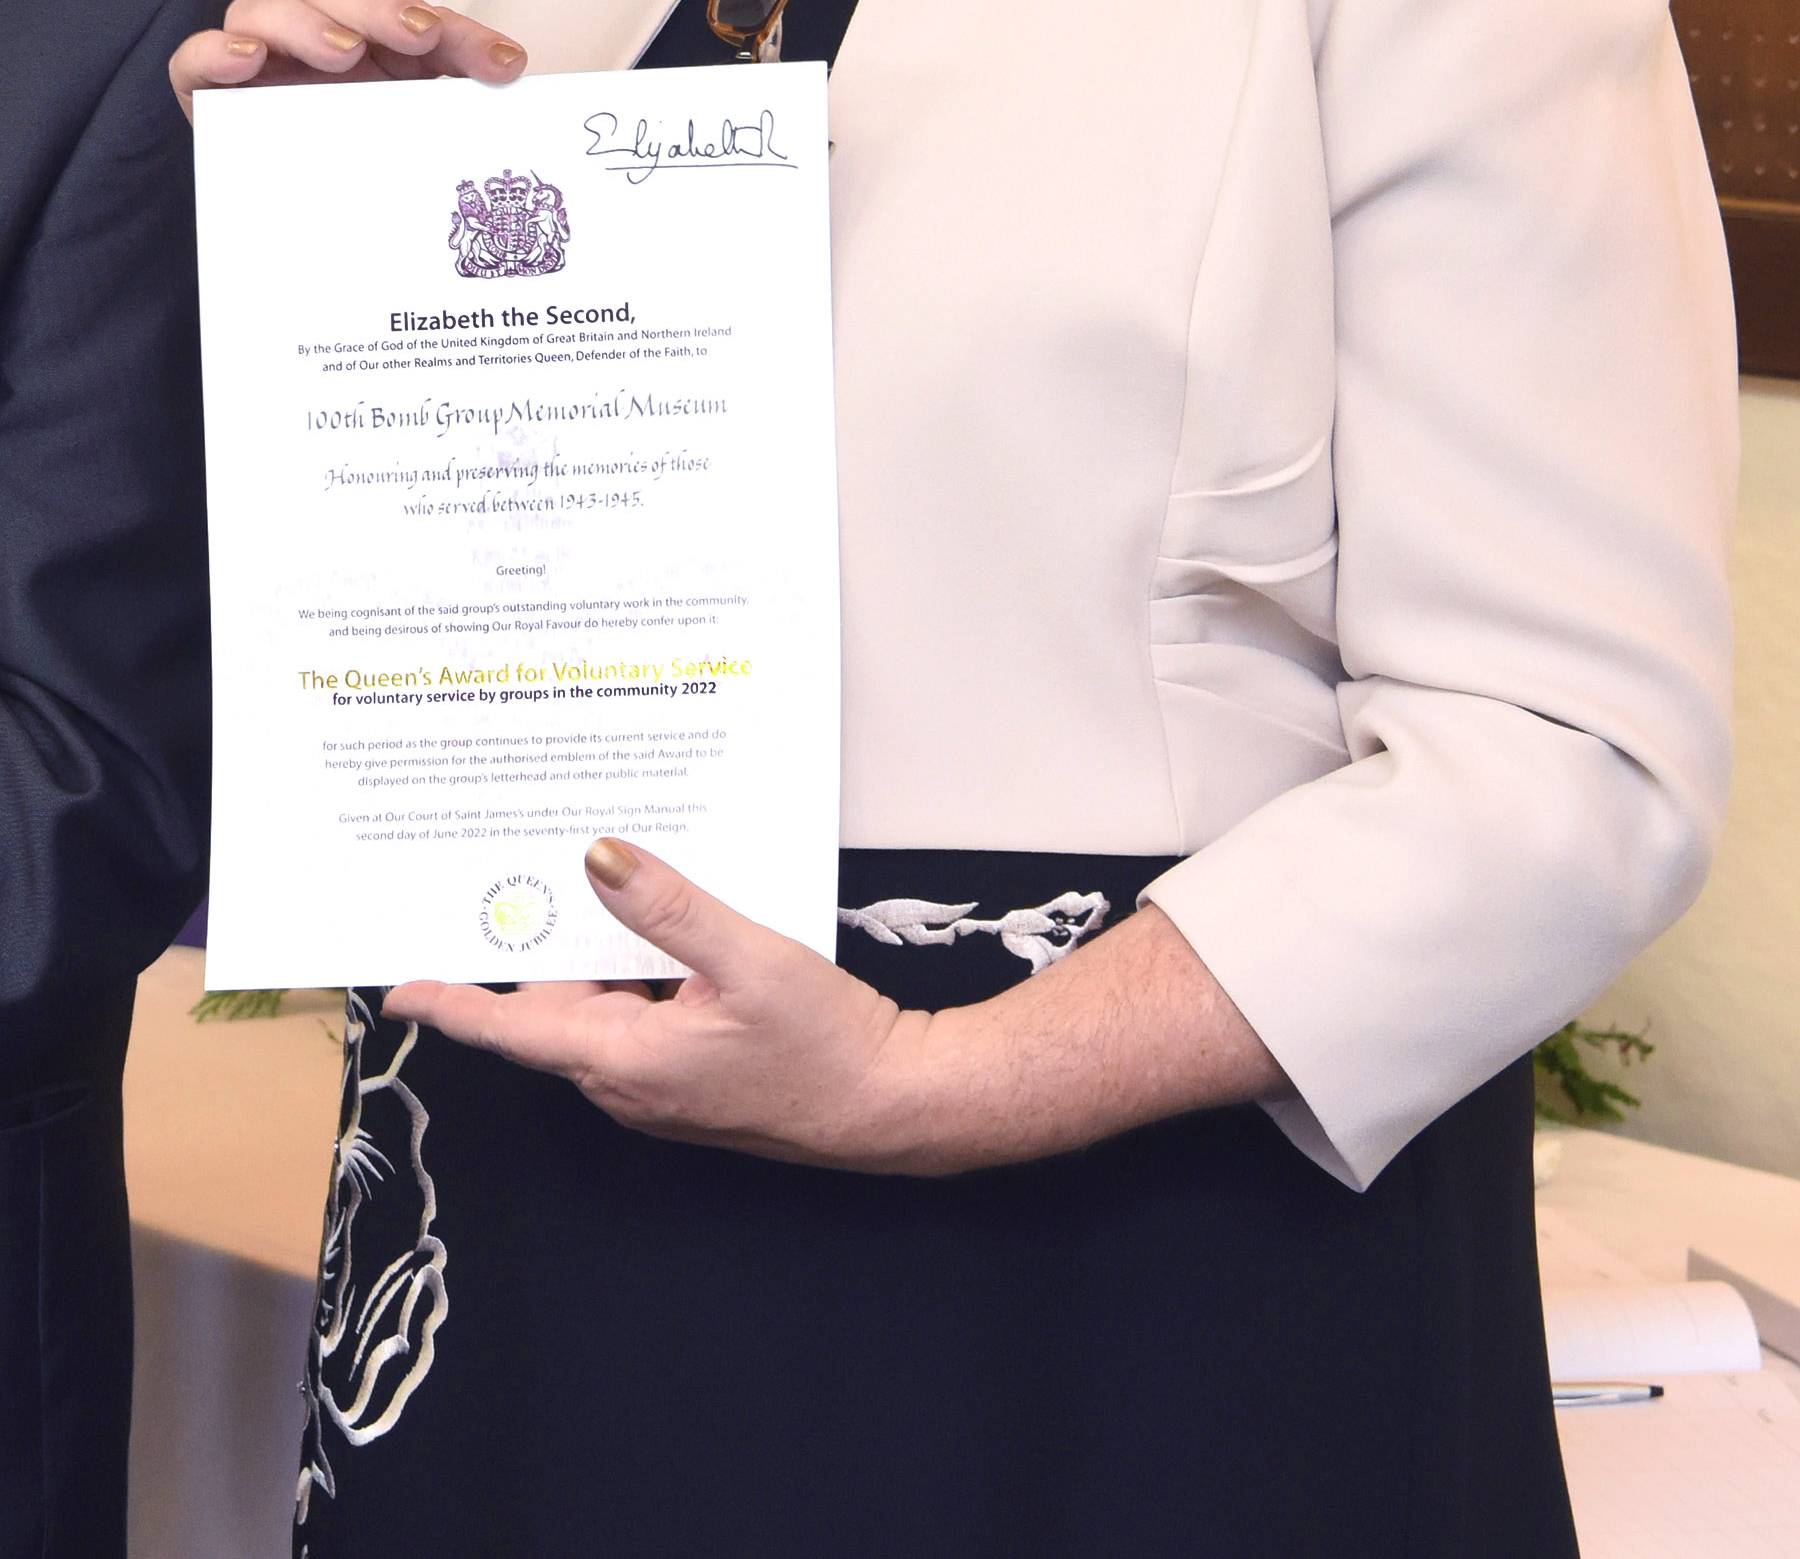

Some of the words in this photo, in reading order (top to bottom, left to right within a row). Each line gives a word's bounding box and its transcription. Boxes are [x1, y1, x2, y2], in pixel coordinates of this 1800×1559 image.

[391, 308, 494, 332] Elizabeth
[501, 307, 538, 327] the
[546, 302, 635, 325] Second,
[297, 344, 311, 357] By
[313, 343, 332, 354] the
[333, 342, 365, 354] Grace
[367, 340, 379, 352] of
[380, 339, 404, 352] God
[406, 338, 418, 351] of
[419, 338, 439, 350] the
[440, 336, 478, 349] United
[480, 334, 530, 349] Kingdom
[532, 332, 545, 345] of
[546, 333, 577, 344] Great
[578, 331, 615, 343] Britain
[616, 329, 639, 341] and
[641, 328, 691, 340] Northern
[693, 326, 732, 338] Ireland
[322, 360, 343, 372] and
[345, 359, 357, 371] of
[358, 359, 380, 371] Our
[381, 358, 412, 370] other
[414, 356, 453, 368] Realms
[455, 354, 476, 367] and
[477, 352, 533, 366] Territories
[534, 352, 575, 364] Queen,
[575, 348, 627, 362] Defender
[628, 347, 641, 359] of
[643, 347, 662, 359] the
[664, 345, 694, 358] Faith,
[695, 347, 708, 356] to
[308, 401, 364, 430] 100th
[371, 398, 431, 428] Bomb
[436, 402, 503, 438] Group
[504, 389, 624, 424] Memorial
[624, 393, 727, 420] Museum
[325, 462, 418, 491] Honouring
[422, 457, 455, 482] and
[456, 458, 539, 488] preserving
[544, 454, 568, 477] the
[573, 452, 647, 475] memories
[652, 451, 670, 480] of
[671, 450, 711, 472] those
[404, 495, 433, 515] who
[438, 490, 490, 515] served
[492, 491, 554, 513] between
[495, 563, 546, 578] Greeting!
[297, 609, 316, 620] We
[317, 608, 348, 621] being
[350, 606, 402, 621] cognisant
[404, 604, 416, 617] of
[417, 604, 436, 616] the
[437, 603, 460, 616] said
[461, 602, 501, 617] group's
[502, 600, 567, 614] outstanding
[569, 599, 621, 612] voluntary
[622, 597, 650, 609] work
[652, 597, 663, 608] in
[665, 596, 684, 608] the
[328, 625, 349, 637] and
[351, 625, 382, 638] being
[384, 624, 429, 636] desirous
[430, 622, 443, 634] of
[444, 621, 490, 635] showing
[491, 620, 512, 632] Our
[514, 618, 544, 634] Royal
[545, 619, 582, 630] Favour
[583, 616, 599, 629] do
[601, 616, 639, 630] hereby
[640, 614, 674, 627] confer
[677, 616, 706, 627] upon
[298, 670, 338, 690] The
[345, 667, 432, 691] Queen's
[439, 663, 510, 686] Award
[516, 663, 547, 683] for
[553, 660, 664, 683] Voluntary
[672, 656, 752, 678] Service
[332, 691, 353, 706] for
[356, 689, 423, 706] voluntary
[426, 688, 476, 703] service
[478, 688, 497, 705] by
[499, 689, 550, 704] groups
[552, 685, 566, 699] in
[569, 684, 594, 699] the
[596, 682, 678, 699] community
[681, 681, 717, 695] 2022
[322, 740, 338, 752] for
[340, 738, 366, 752] such
[366, 737, 403, 752] period
[405, 740, 418, 749] as
[419, 737, 438, 749] the
[439, 738, 473, 751] group
[475, 736, 529, 747] continues
[531, 735, 543, 745] to
[545, 732, 588, 747] provide
[589, 733, 603, 743] its
[604, 732, 644, 743] current
[647, 730, 686, 742] service
[687, 728, 709, 740] and
[711, 728, 727, 740] do
[324, 758, 363, 772] hereby
[364, 759, 388, 771] give
[389, 756, 449, 770] permission
[451, 754, 467, 766] for
[469, 754, 488, 766] the
[489, 752, 548, 765] authorised
[550, 751, 596, 763] emblem
[598, 750, 610, 761] of
[612, 749, 631, 761] the
[633, 748, 655, 760] said
[657, 747, 693, 759] Award
[695, 749, 707, 758] to
[709, 747, 724, 758] be
[357, 774, 409, 789] displayed
[411, 776, 426, 785] on
[428, 773, 447, 785] the
[448, 772, 489, 787] group's
[491, 770, 547, 783] letterhead
[549, 769, 571, 781] and
[572, 769, 603, 780] other
[605, 768, 639, 781] public
[481, 880, 505, 904] THE
[478, 911, 515, 953] GOLDEN
[519, 910, 558, 953] JUBILEE
